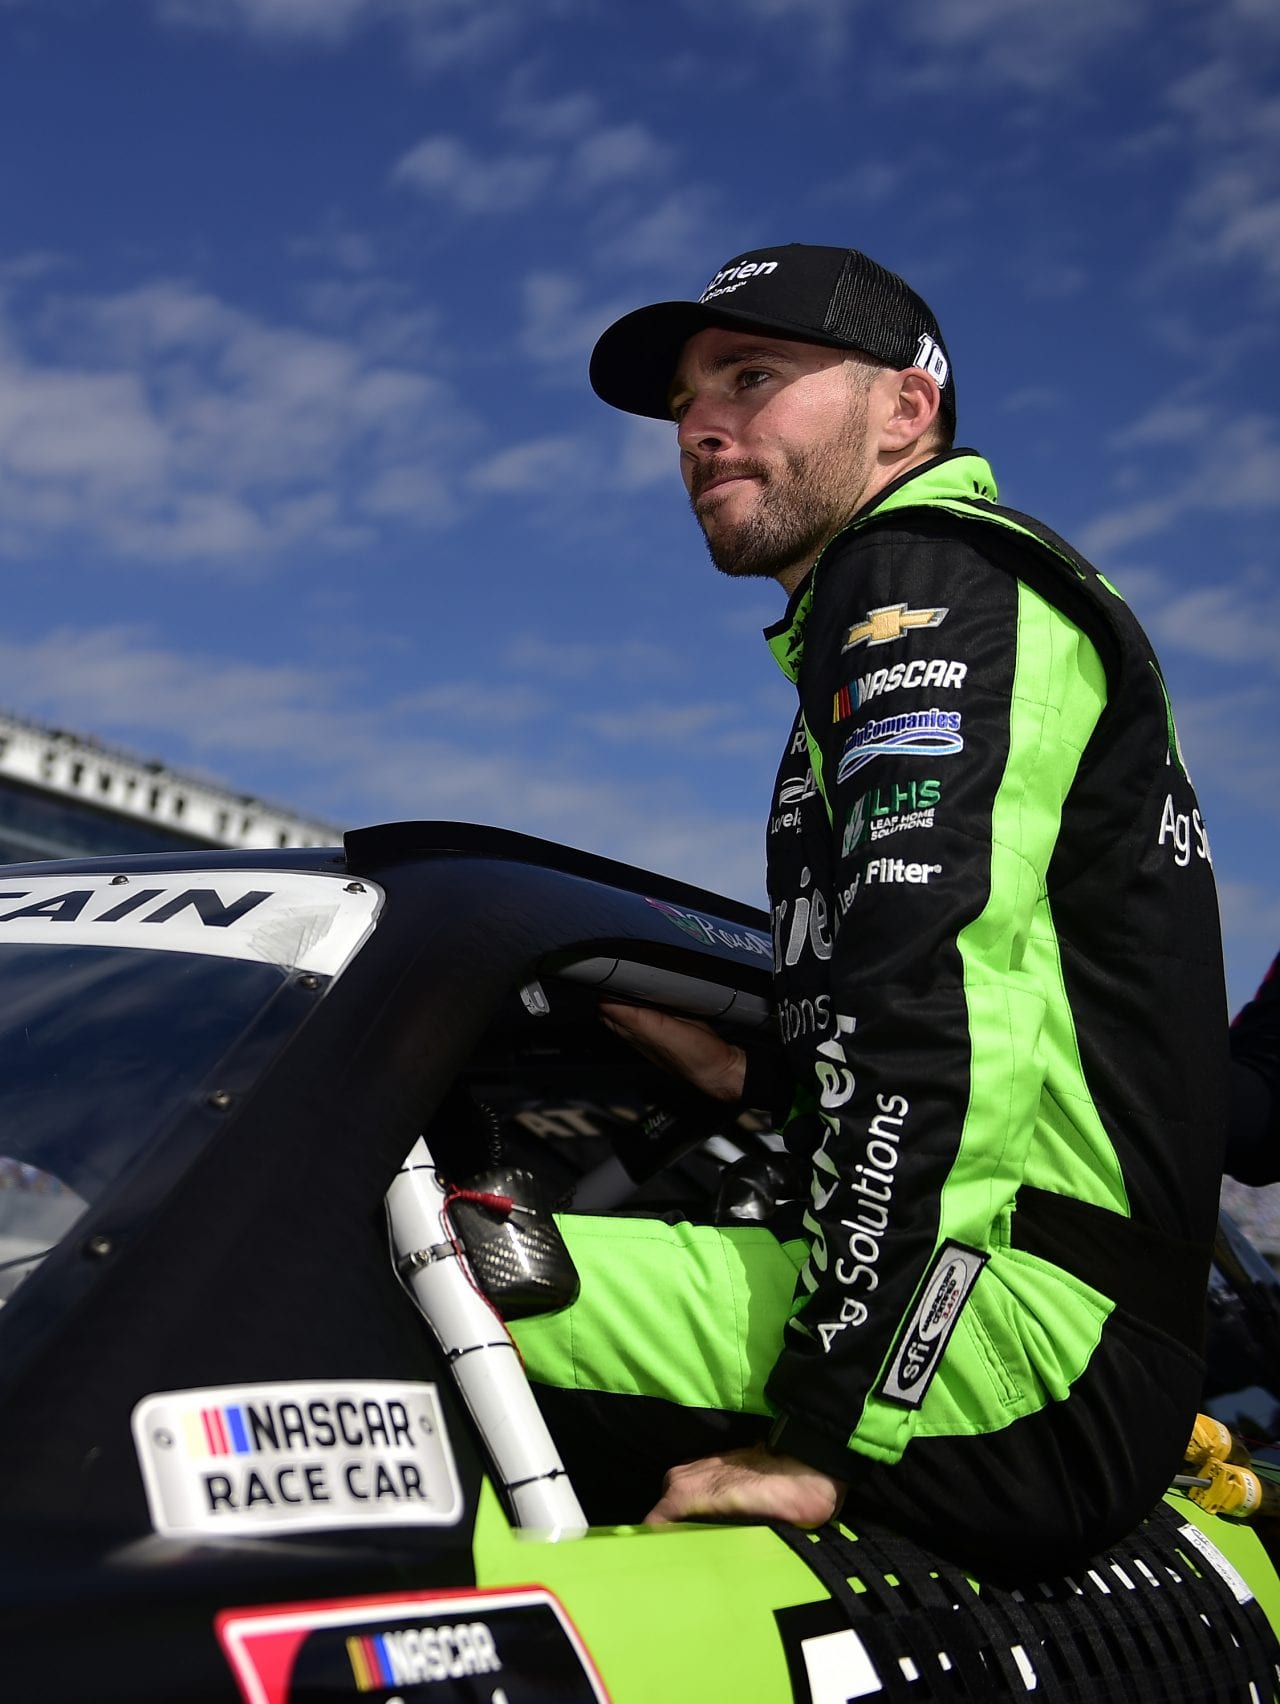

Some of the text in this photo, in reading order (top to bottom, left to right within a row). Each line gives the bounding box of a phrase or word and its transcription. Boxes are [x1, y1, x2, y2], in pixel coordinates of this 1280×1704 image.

[913, 333, 948, 389] 10
[854, 658, 968, 707] NASCAR
[870, 807, 936, 831] LEAF HOME
[872, 779, 942, 817] LHS
[870, 817, 935, 841] SOLUTIONS
[1158, 793, 1191, 867] Ag
[834, 1093, 910, 1291] Solutions
[921, 1265, 957, 1333] MANUFACTURER
[932, 1279, 957, 1325] CERTIFIED
[817, 1297, 868, 1354] Ag
[902, 1338, 932, 1380] sfi
[246, 1401, 416, 1452] NASCAR
[205, 1461, 426, 1515] RACE CAR
[383, 1622, 504, 1688] NASCAR
